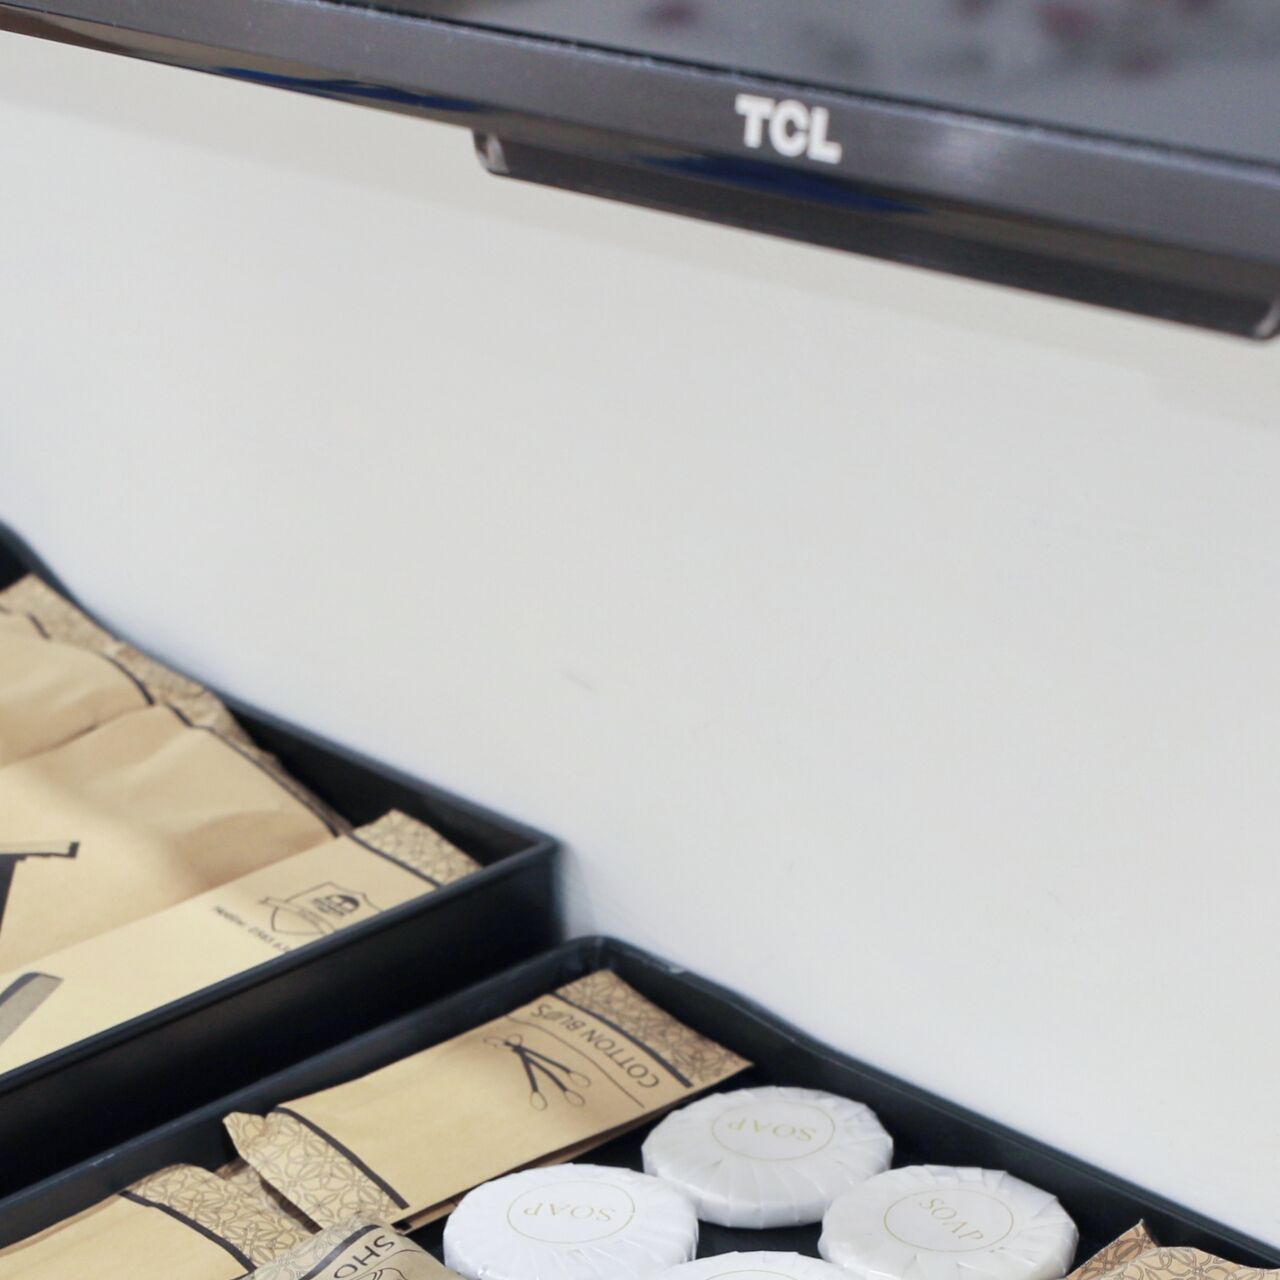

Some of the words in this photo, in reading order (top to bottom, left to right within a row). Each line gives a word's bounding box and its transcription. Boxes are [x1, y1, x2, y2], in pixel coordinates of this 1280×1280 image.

[734, 93, 842, 165] TCL
[579, 1029, 660, 1089] COTTON
[727, 1115, 817, 1143] SOAP
[523, 1202, 616, 1222] SOAP
[918, 1197, 984, 1241] SOAP
